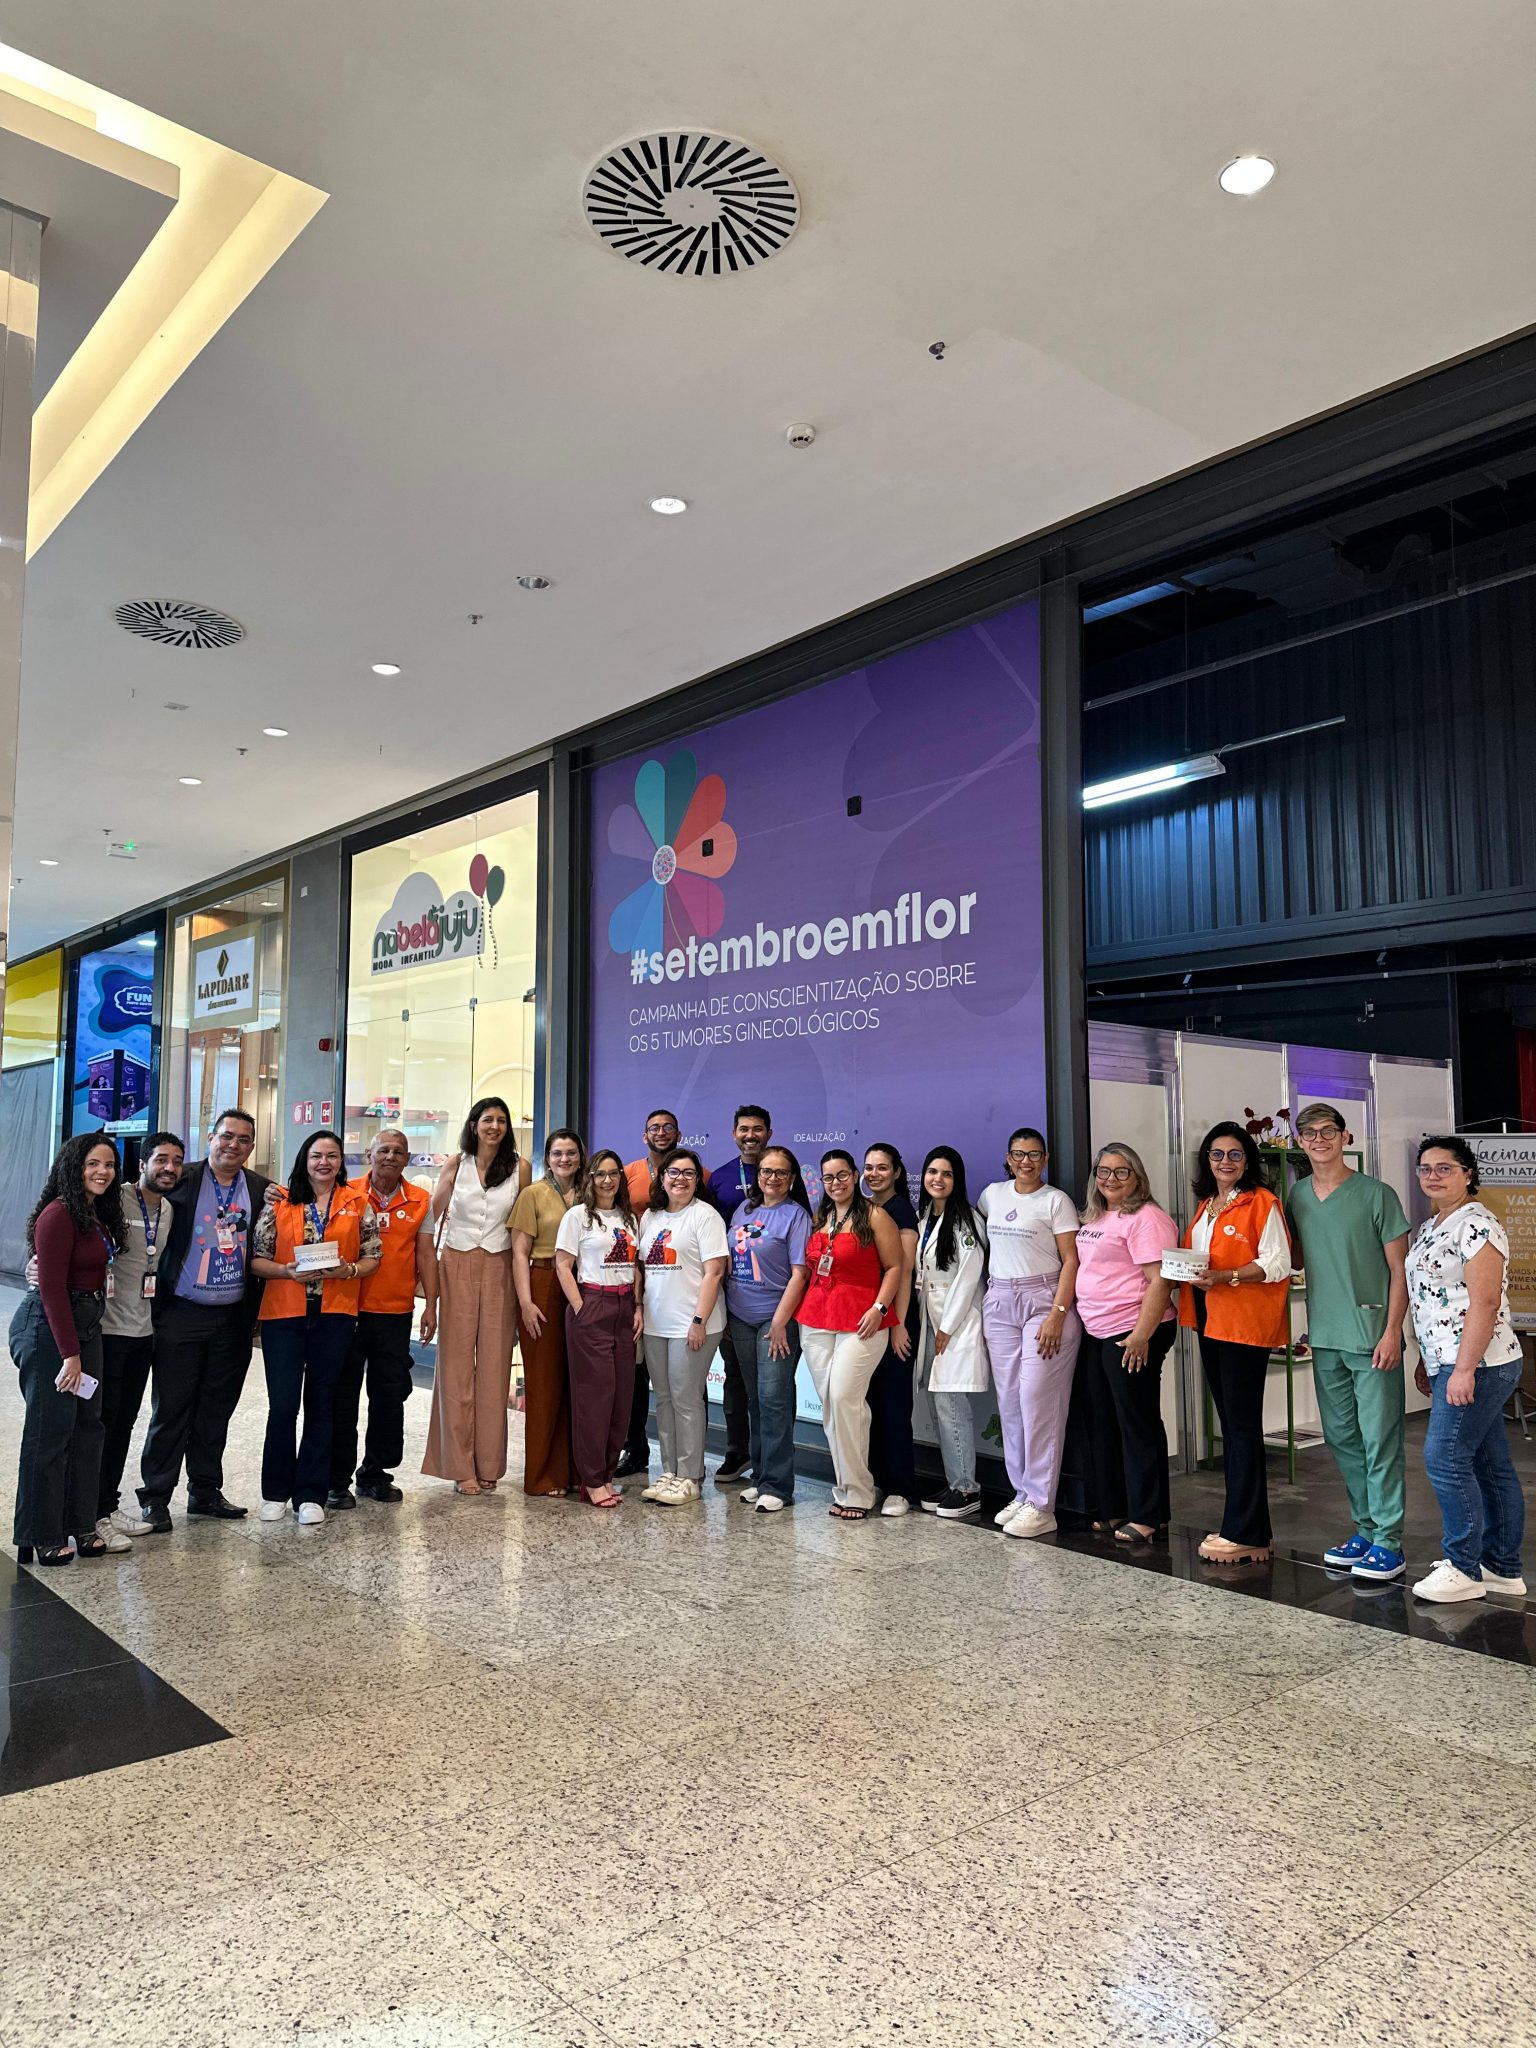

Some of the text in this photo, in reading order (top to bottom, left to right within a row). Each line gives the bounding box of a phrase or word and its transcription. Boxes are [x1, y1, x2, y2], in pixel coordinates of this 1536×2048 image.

[630, 891, 977, 985] #setembroemflor
[372, 950, 436, 971] MODA INFANTIL
[197, 973, 249, 1000] LAPIDARE
[629, 961, 977, 1026] CAMPANHA DE CONSCIENTIZAÇÃO SOBRE
[126, 992, 152, 1003] FUN
[629, 1007, 881, 1053] OS 5 TUMORES GINECOLÓGICOS
[676, 1134, 707, 1148] ZAÇÃO
[793, 1131, 846, 1143] IDEALIZAÇÃO
[1478, 1166, 1505, 1176] COM
[1506, 1216, 1522, 1224] DE
